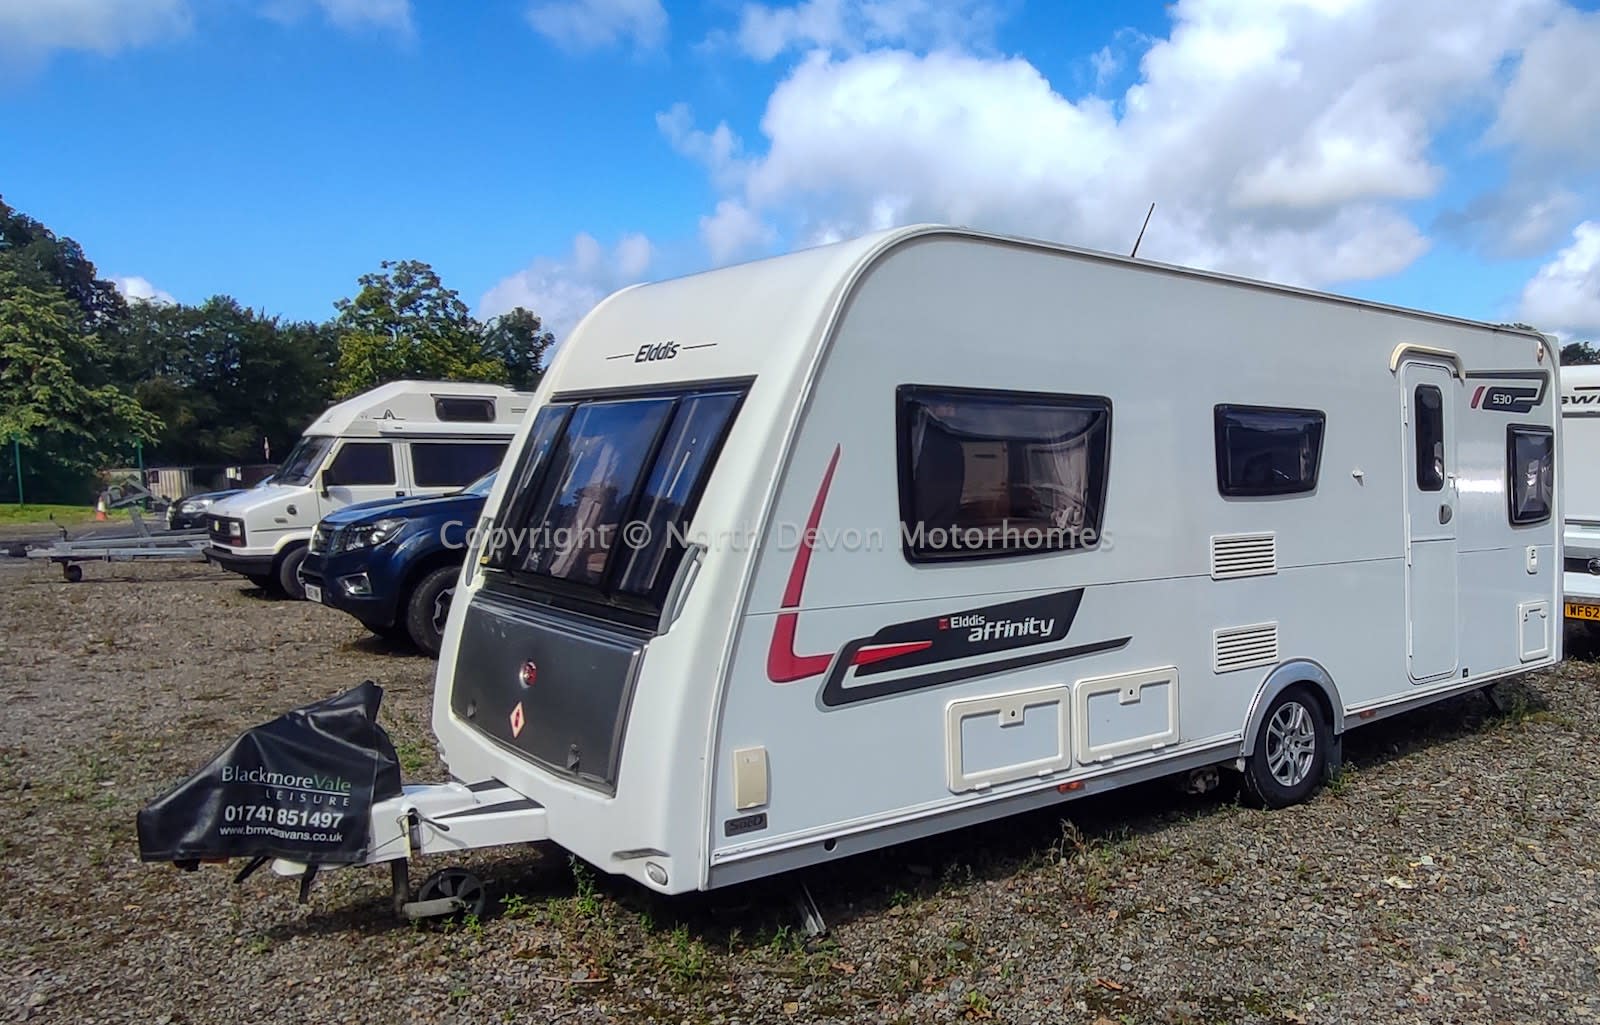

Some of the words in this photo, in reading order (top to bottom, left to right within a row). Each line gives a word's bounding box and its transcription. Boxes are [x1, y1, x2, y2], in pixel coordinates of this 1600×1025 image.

[635, 341, 681, 363] Elddis
[1492, 394, 1512, 405] 530
[950, 615, 985, 629] Elddis
[967, 617, 1055, 642] affinity
[221, 765, 351, 793] BlackmoreVale
[265, 789, 350, 807] LEISURE
[224, 804, 274, 822] 01747
[277, 808, 344, 829] 851497
